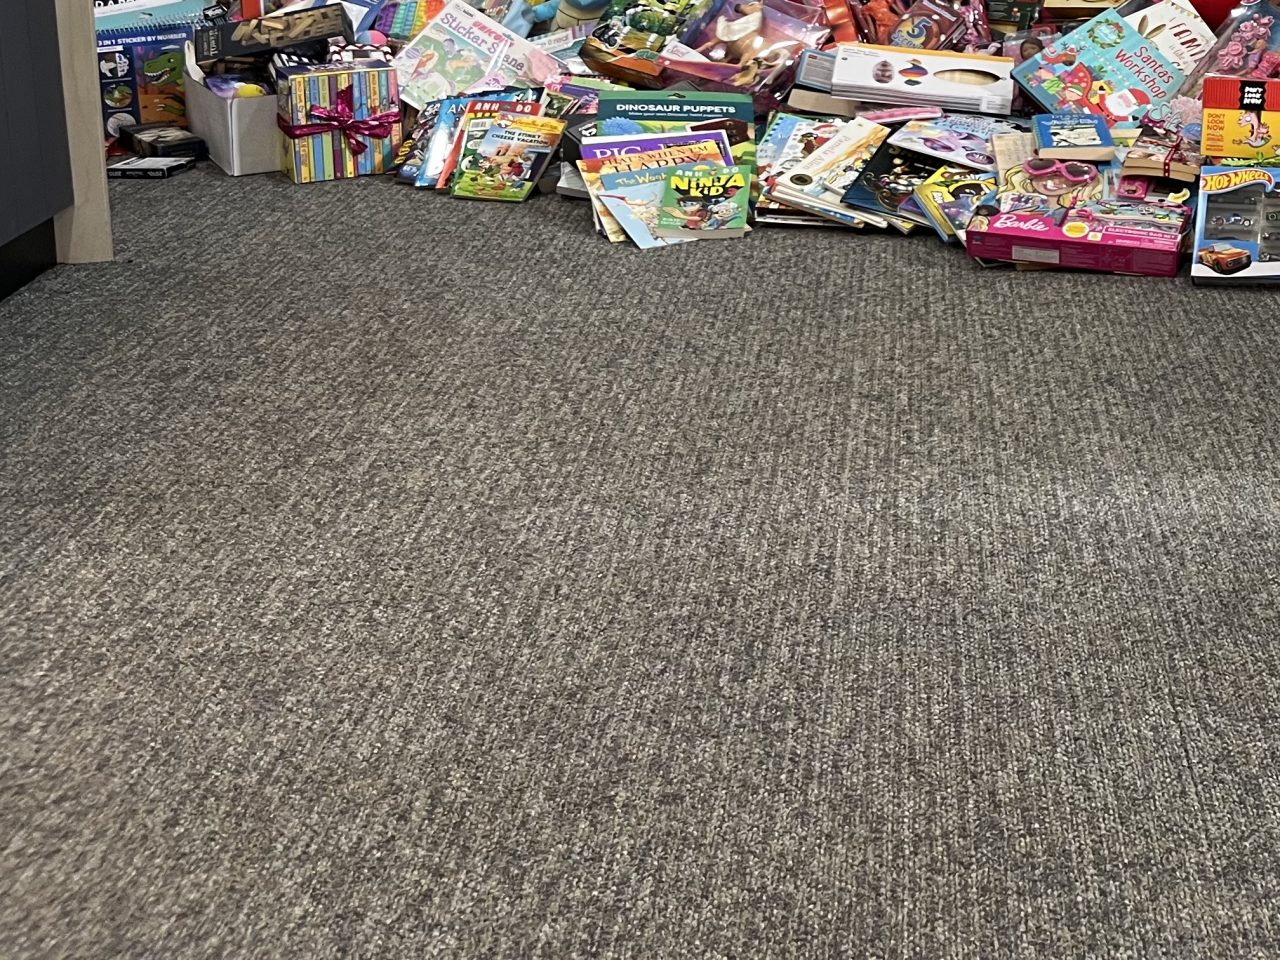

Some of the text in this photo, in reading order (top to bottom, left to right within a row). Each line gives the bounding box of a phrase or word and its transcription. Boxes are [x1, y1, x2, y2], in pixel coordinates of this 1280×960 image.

[440, 12, 488, 48] Sticker
[906, 17, 933, 39] 5
[117, 36, 147, 44] STICKER
[157, 32, 187, 41] NUMBER
[1134, 45, 1175, 85] Santa's
[1114, 48, 1168, 100] Workshop
[474, 102, 532, 113] ANH DO
[616, 104, 736, 113] DINOSAUR PUPPETS
[491, 133, 549, 146] CHEESE VACATION
[644, 148, 684, 162] WHEN
[993, 214, 1050, 232] Barbie
